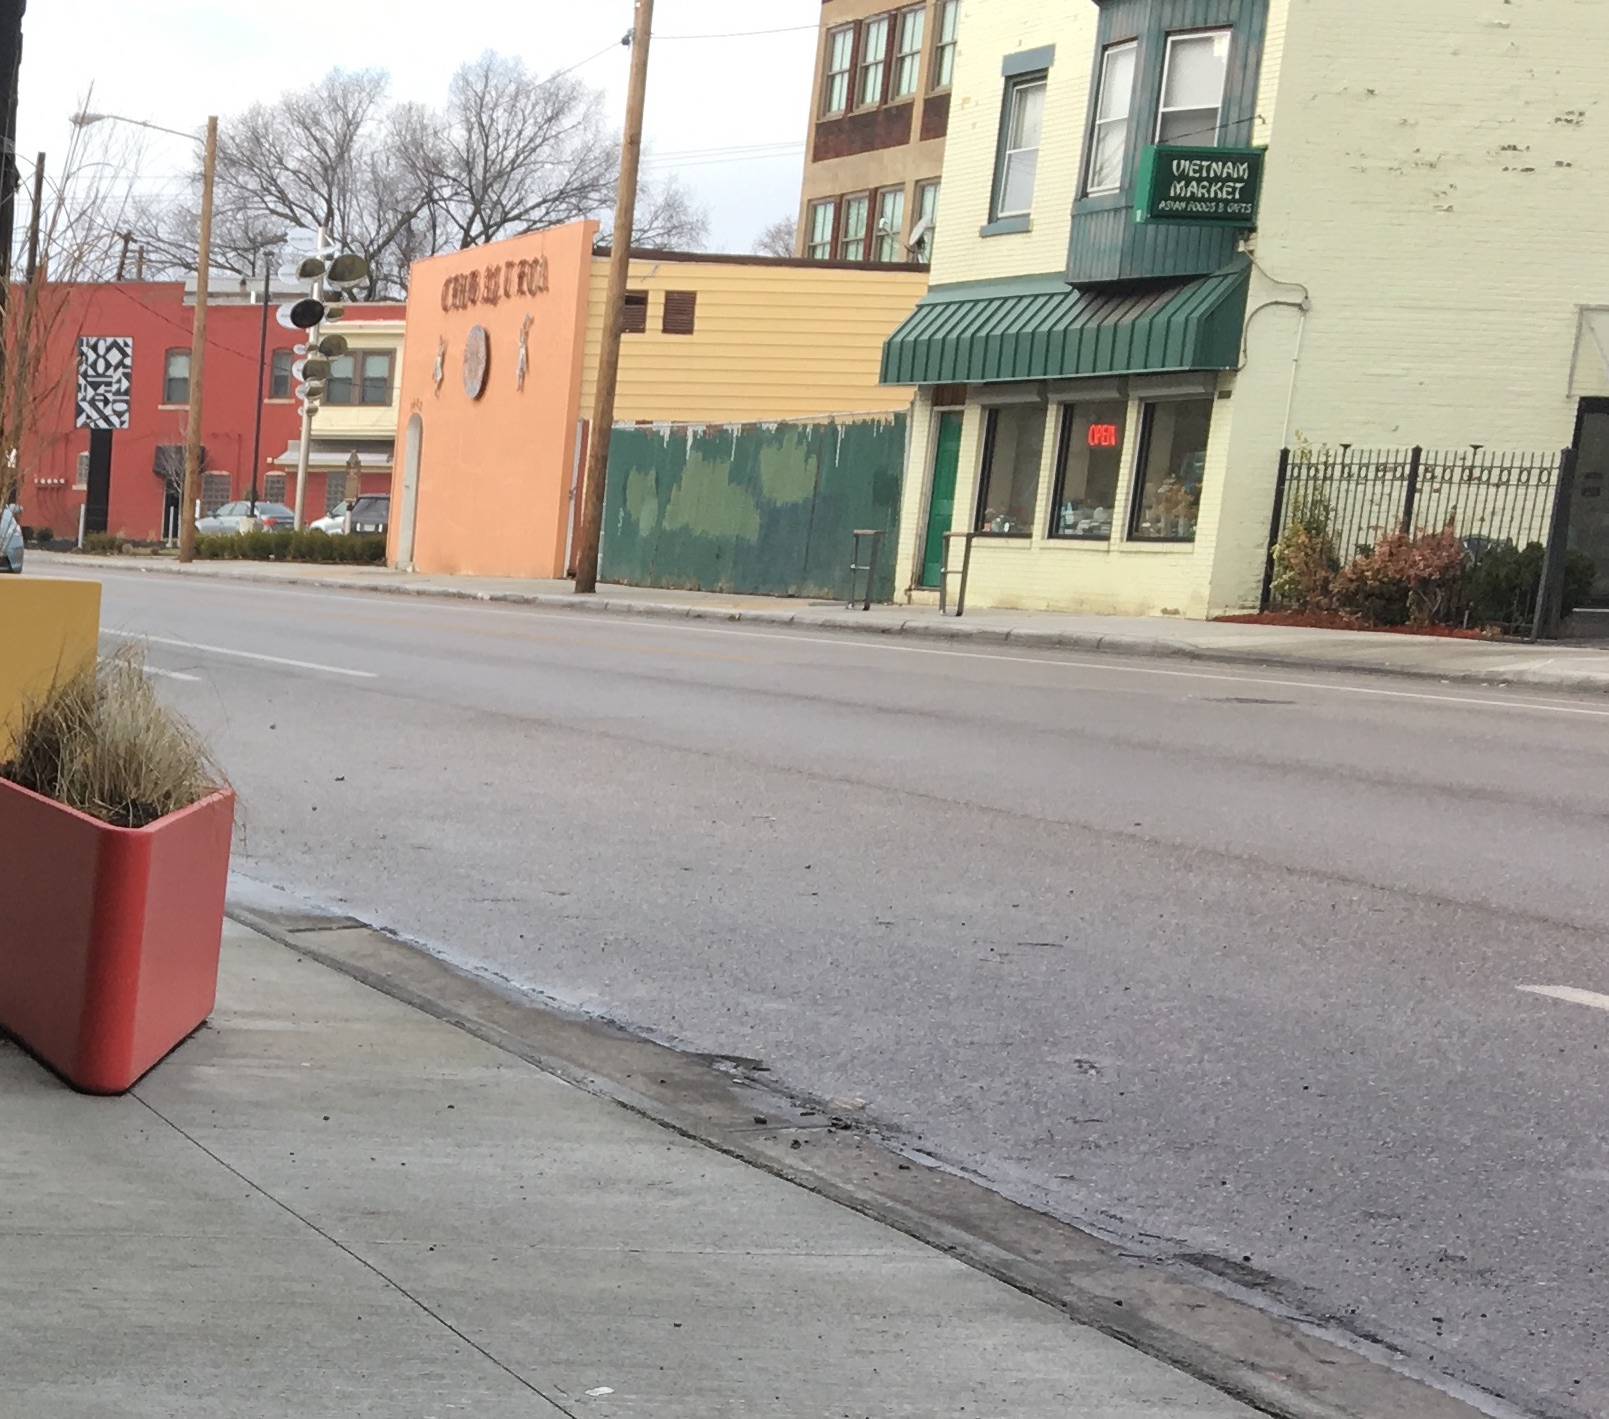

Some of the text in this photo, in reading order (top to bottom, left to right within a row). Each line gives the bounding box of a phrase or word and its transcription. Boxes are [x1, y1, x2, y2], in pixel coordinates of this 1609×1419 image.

[1172, 159, 1249, 179] VIETNAM
[1169, 180, 1246, 199] MARKET
[1088, 424, 1117, 446] OPEN
